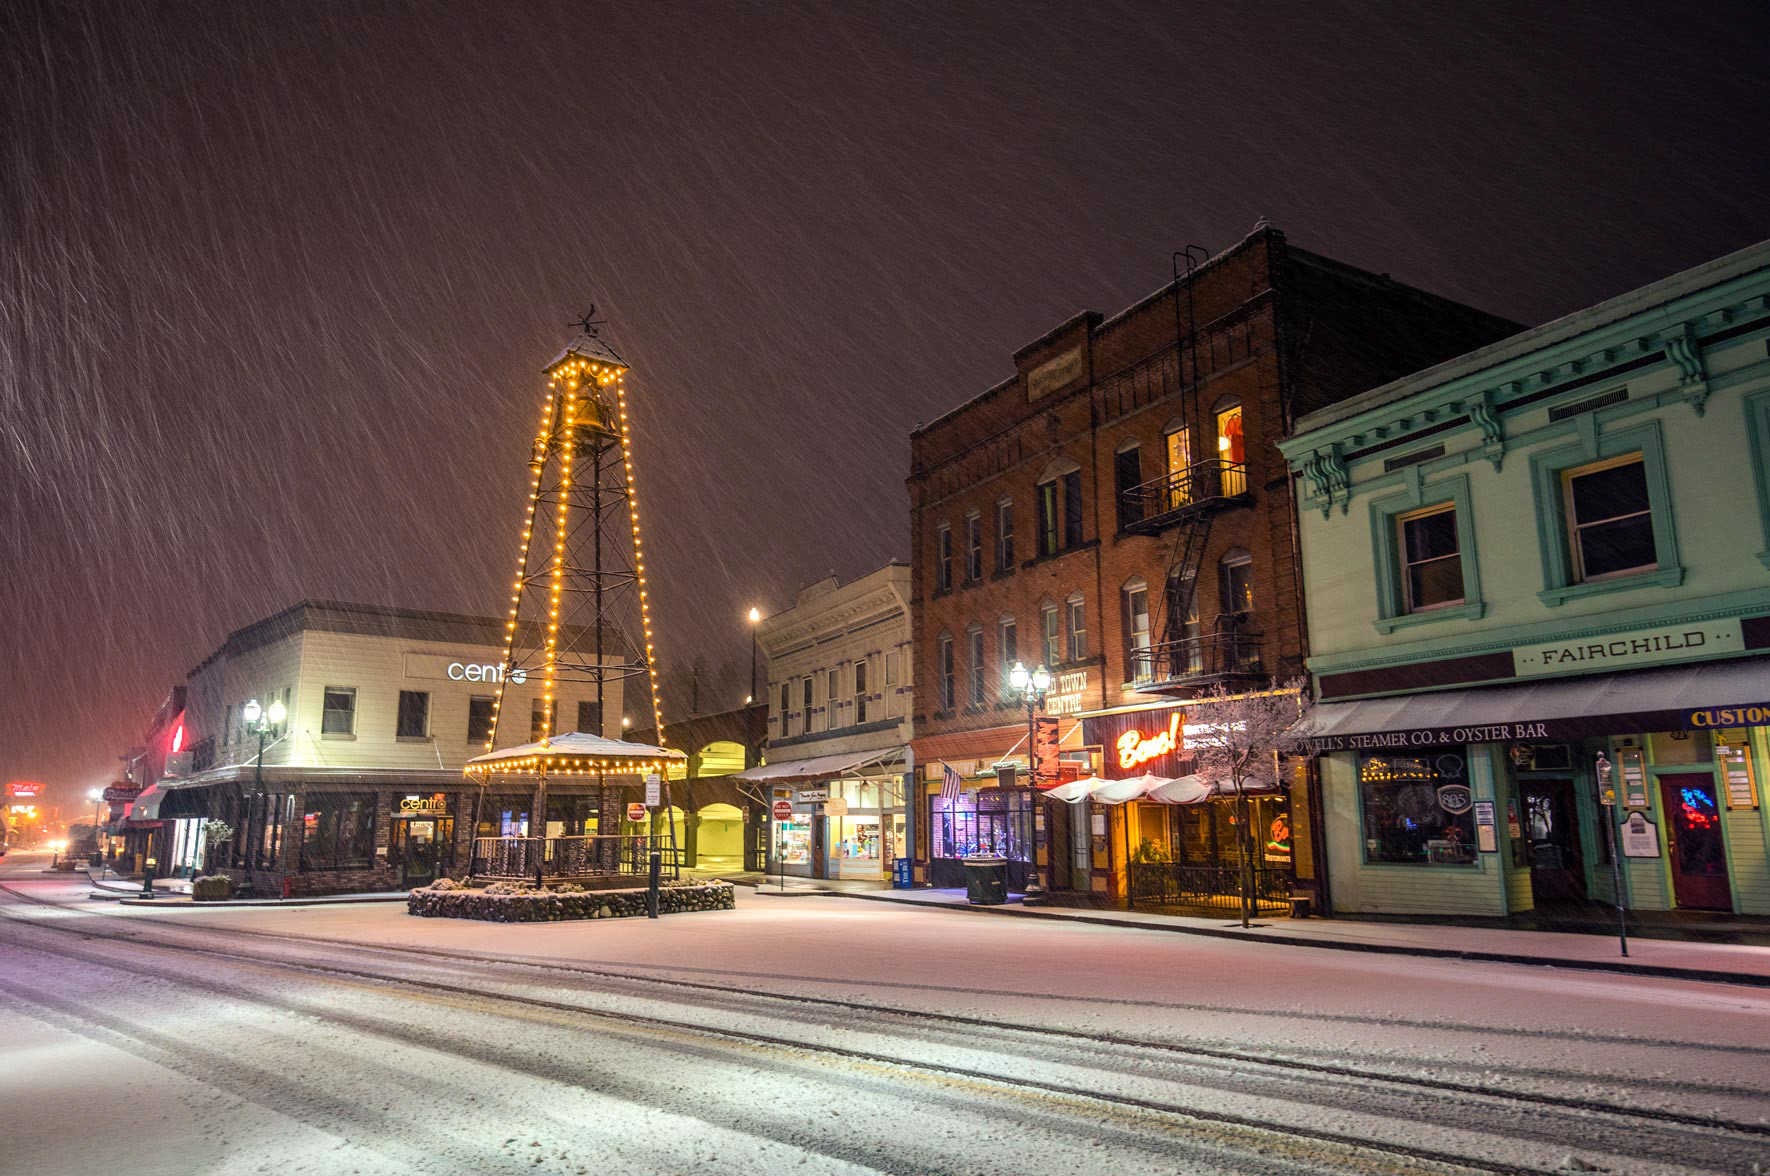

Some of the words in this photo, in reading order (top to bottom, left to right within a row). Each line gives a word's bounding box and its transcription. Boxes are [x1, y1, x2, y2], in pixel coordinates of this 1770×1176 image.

[1542, 631, 1705, 665] FAIRCHILD
[1060, 671, 1087, 694] TOWN
[1047, 693, 1082, 715] CENTRE
[1295, 737, 1344, 753] OWELL'S
[1349, 732, 1408, 749] STEAMER
[1411, 730, 1436, 745] CO.
[1440, 731, 1450, 742] &
[1453, 725, 1511, 742] OYSTER
[1515, 723, 1548, 738] BAR
[400, 796, 446, 809] centro
[1442, 794, 1466, 806] 805
